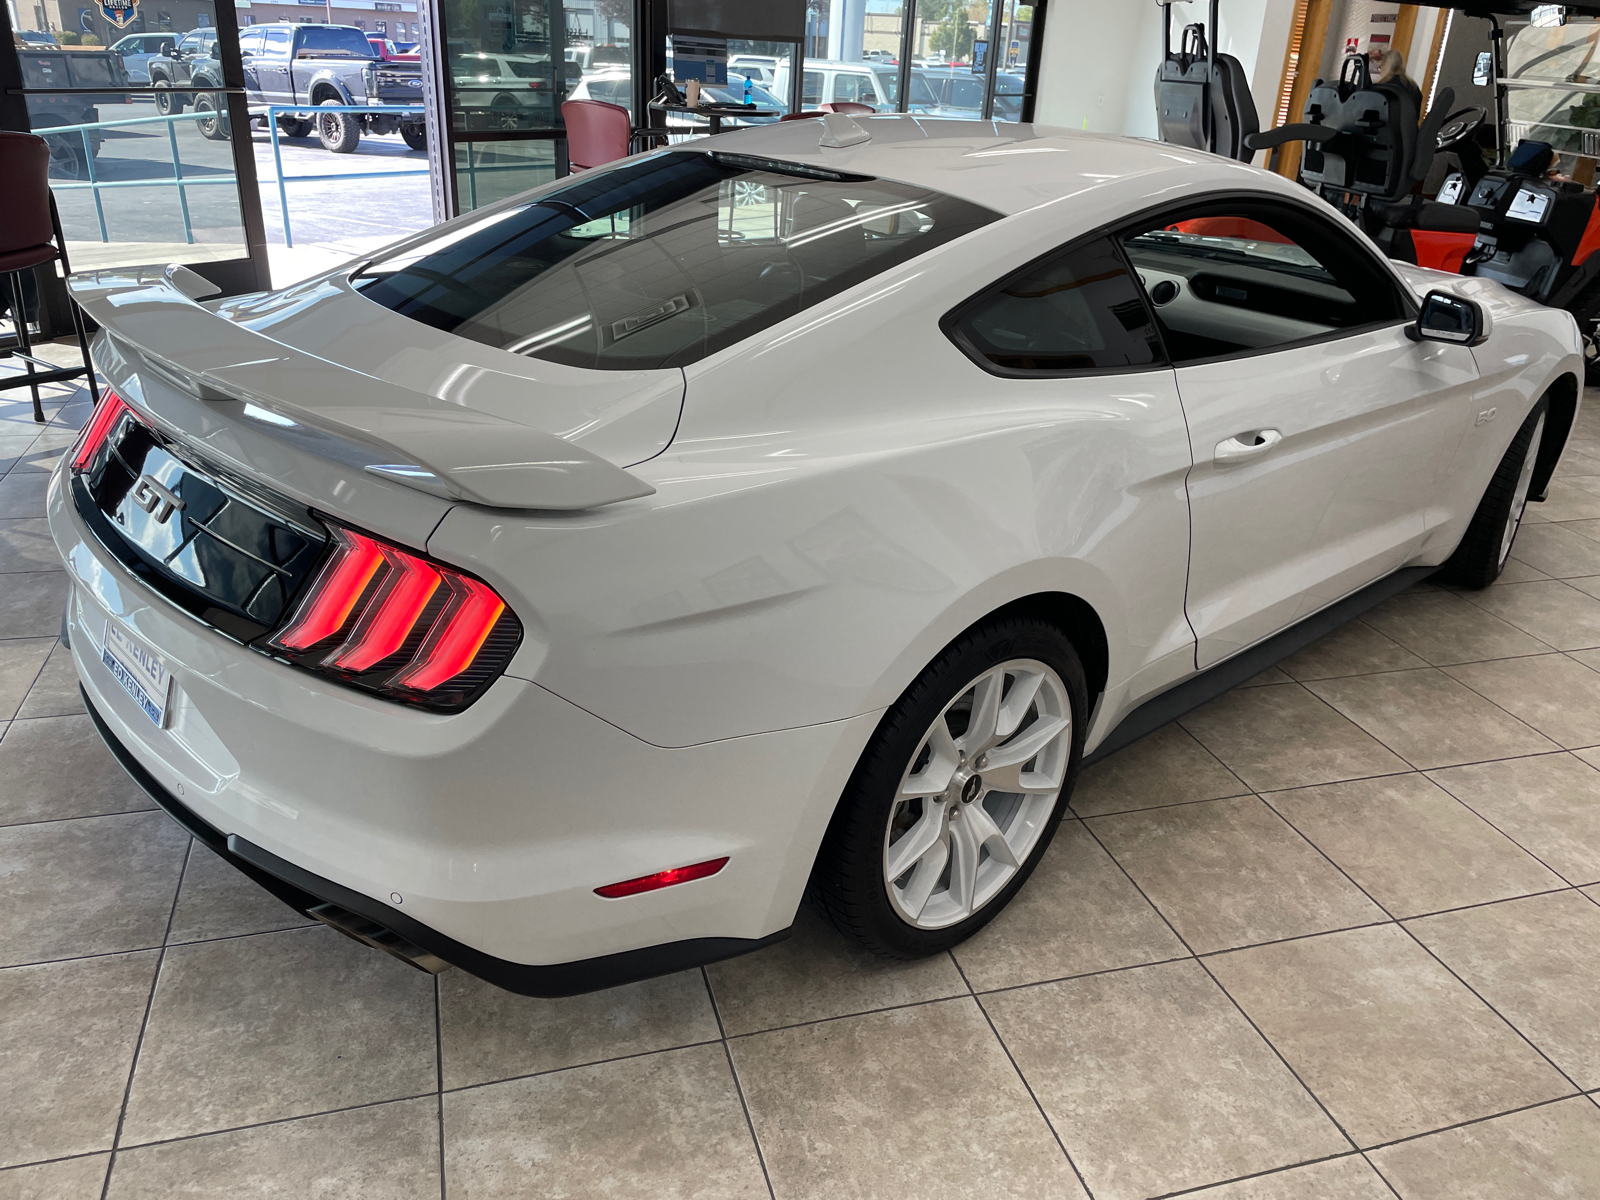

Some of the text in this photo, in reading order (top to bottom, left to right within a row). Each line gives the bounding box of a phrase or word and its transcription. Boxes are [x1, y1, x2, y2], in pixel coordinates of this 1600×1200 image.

[131, 474, 187, 524] GT
[125, 640, 165, 686] KENLEY
[123, 671, 149, 709] KENLEY
